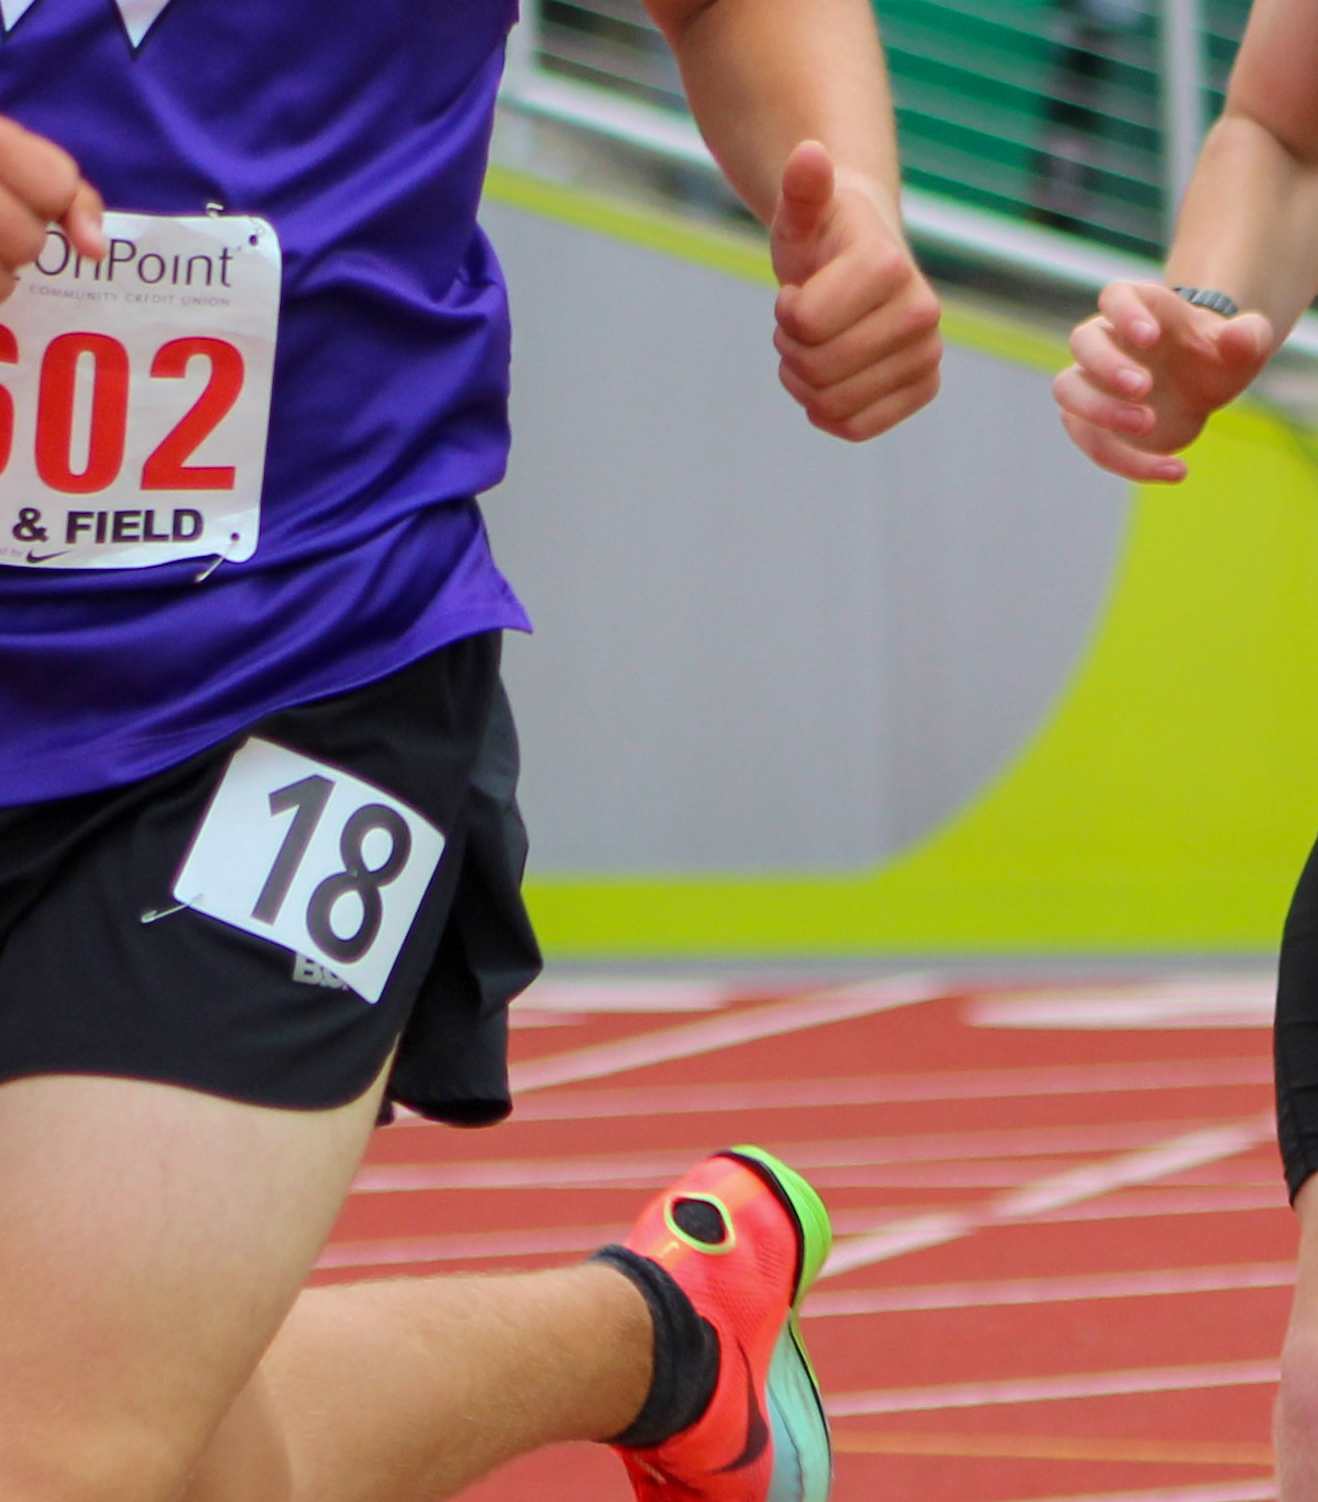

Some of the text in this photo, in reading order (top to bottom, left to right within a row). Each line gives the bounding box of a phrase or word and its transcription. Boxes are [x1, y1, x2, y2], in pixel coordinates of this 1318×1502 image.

[29, 284, 231, 307] COMMUNITY CREDIT UNION
[12, 507, 49, 543] &
[65, 508, 204, 545] FIELD
[250, 773, 413, 966] 18
